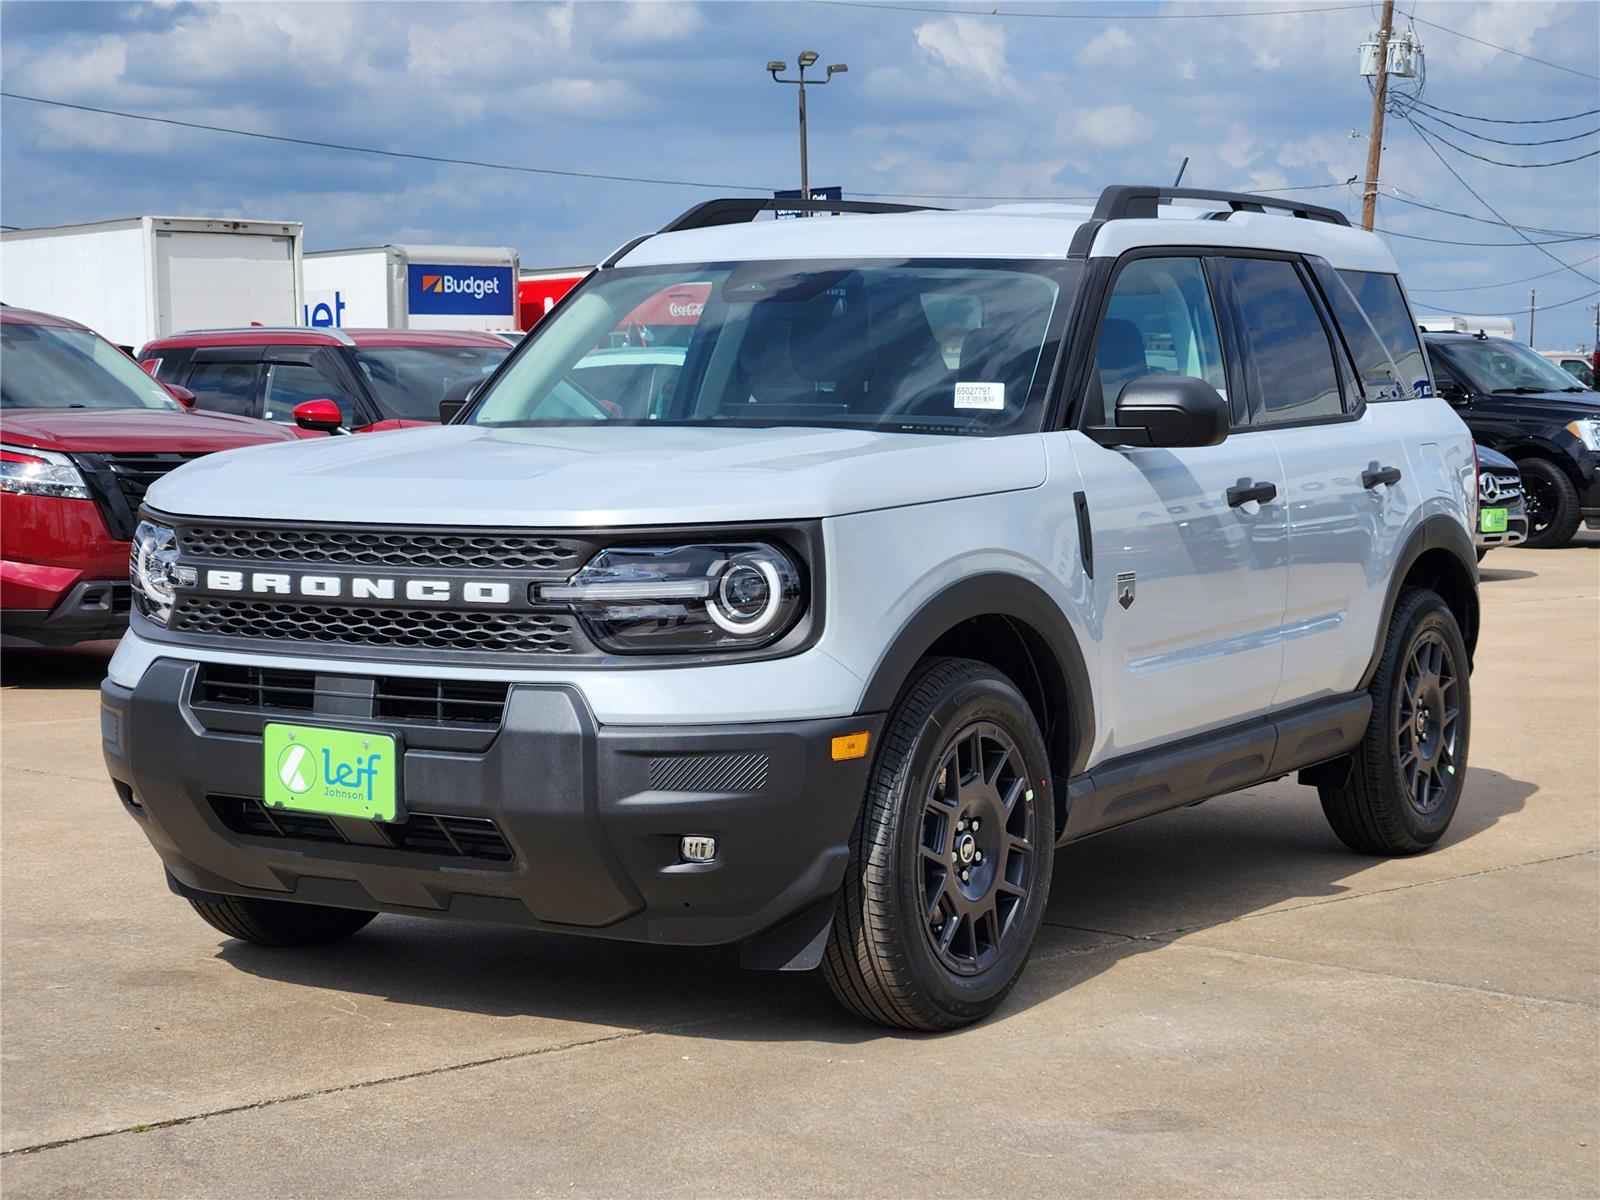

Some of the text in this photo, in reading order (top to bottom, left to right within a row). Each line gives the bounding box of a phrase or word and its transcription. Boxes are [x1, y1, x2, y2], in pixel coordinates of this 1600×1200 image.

[443, 275, 499, 299] Budget
[304, 291, 345, 328] et
[207, 569, 511, 604] BRONCO
[321, 748, 382, 801] leif
[323, 787, 364, 800] Johnson
